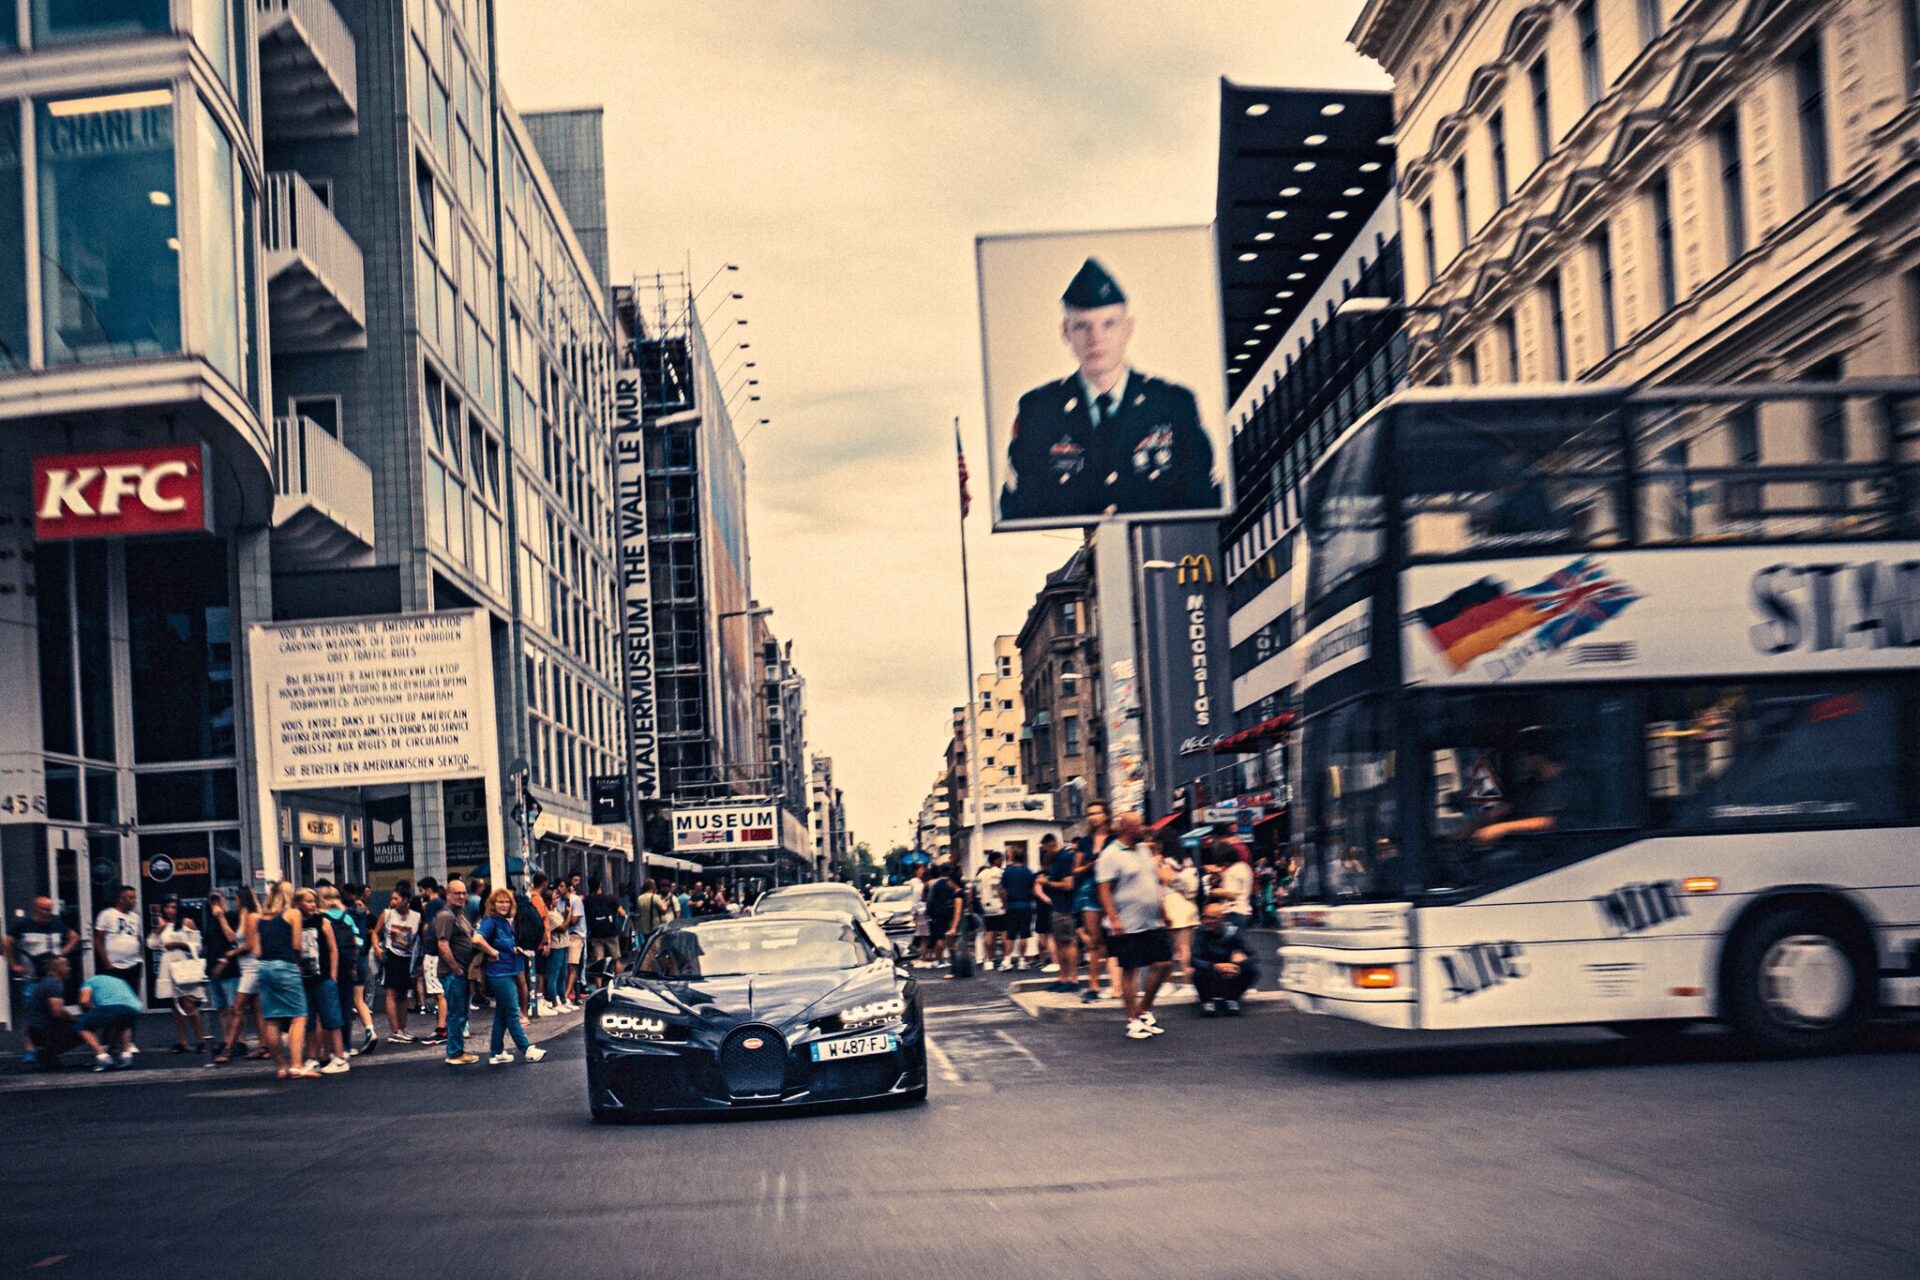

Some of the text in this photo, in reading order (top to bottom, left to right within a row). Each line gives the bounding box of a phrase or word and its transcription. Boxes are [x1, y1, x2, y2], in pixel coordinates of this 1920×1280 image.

[38, 461, 188, 519] KFC
[616, 377, 657, 796] MAUERMUSEUM THE WALL LE MUR
[391, 646, 417, 659] RULES
[281, 719, 304, 731] VOUS
[307, 716, 337, 729] ENTREZ
[341, 715, 365, 727] DANS
[367, 713, 375, 725] LE
[380, 711, 417, 724] SECTEUR
[387, 723, 397, 736] EN
[441, 719, 469, 732] SERVICE
[337, 739, 354, 752] AUX
[391, 736, 401, 749] DE
[405, 734, 460, 749] CIRCULATION
[283, 752, 470, 777] SIE BETRETEN DEN AMERIKANISCHEN SEKTOR
[676, 811, 774, 830] MUSEUM
[373, 844, 404, 856] MAUER
[373, 854, 405, 864] MUSEUM
[176, 860, 207, 872] CASH
